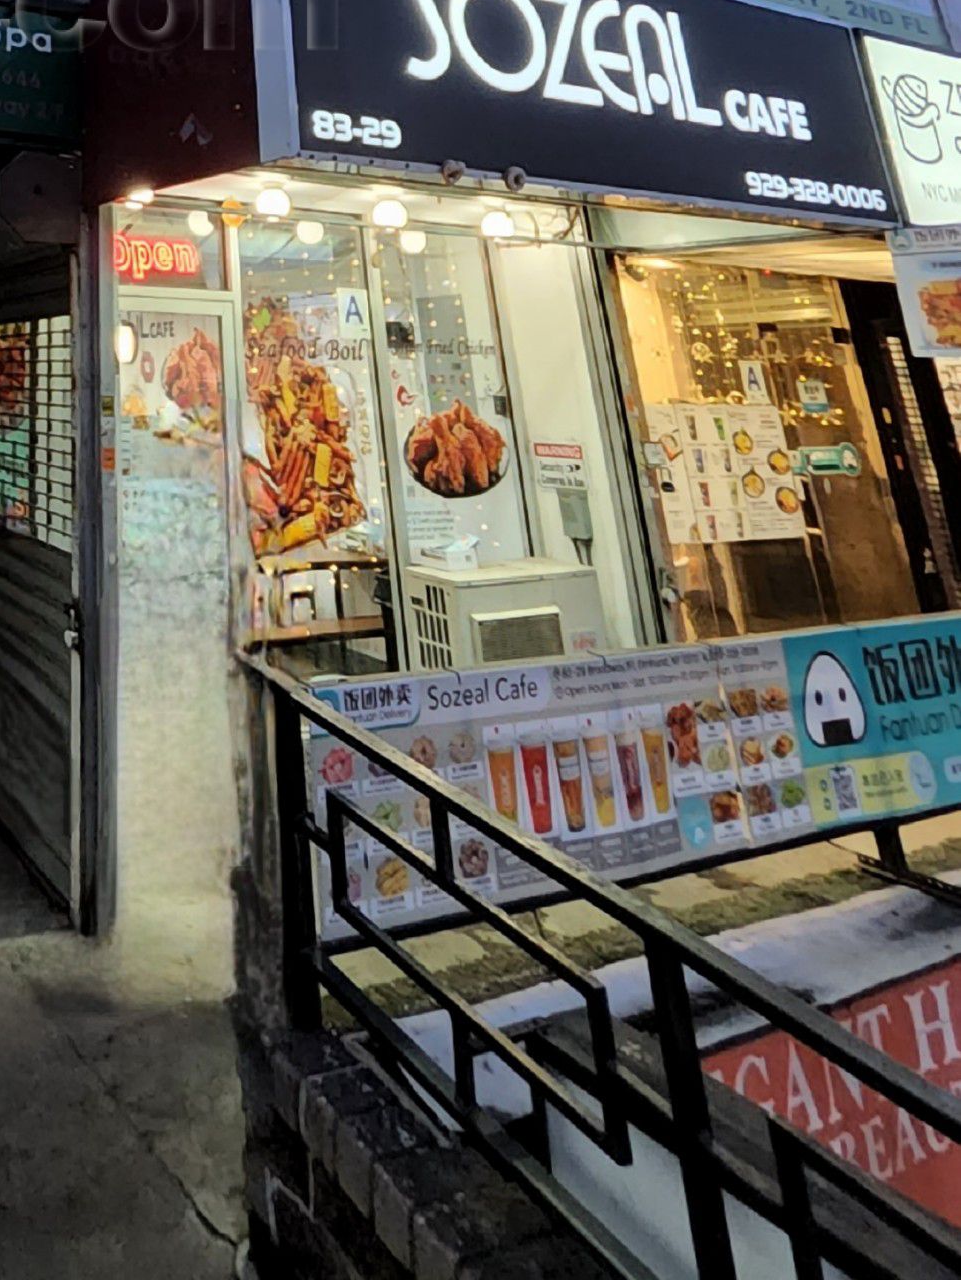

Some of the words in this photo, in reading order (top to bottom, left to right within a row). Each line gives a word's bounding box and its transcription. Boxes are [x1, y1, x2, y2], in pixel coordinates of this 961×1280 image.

[844, 0, 894, 26] 2ND
[901, 13, 929, 36] FL
[722, 89, 813, 141] CAFE
[310, 109, 403, 149] 83-29
[745, 171, 888, 213] 929-328-0006
[113, 233, 200, 280] Open
[345, 295, 364, 325] A
[149, 320, 175, 339] CAFE
[245, 335, 322, 361] Seafood
[325, 337, 370, 362] Boil
[748, 366, 762, 392] A
[342, 683, 412, 712] 饭团外卖
[426, 677, 490, 711] Sozeal
[494, 673, 539, 703] Cafe
[879, 712, 947, 742] Fantuan
